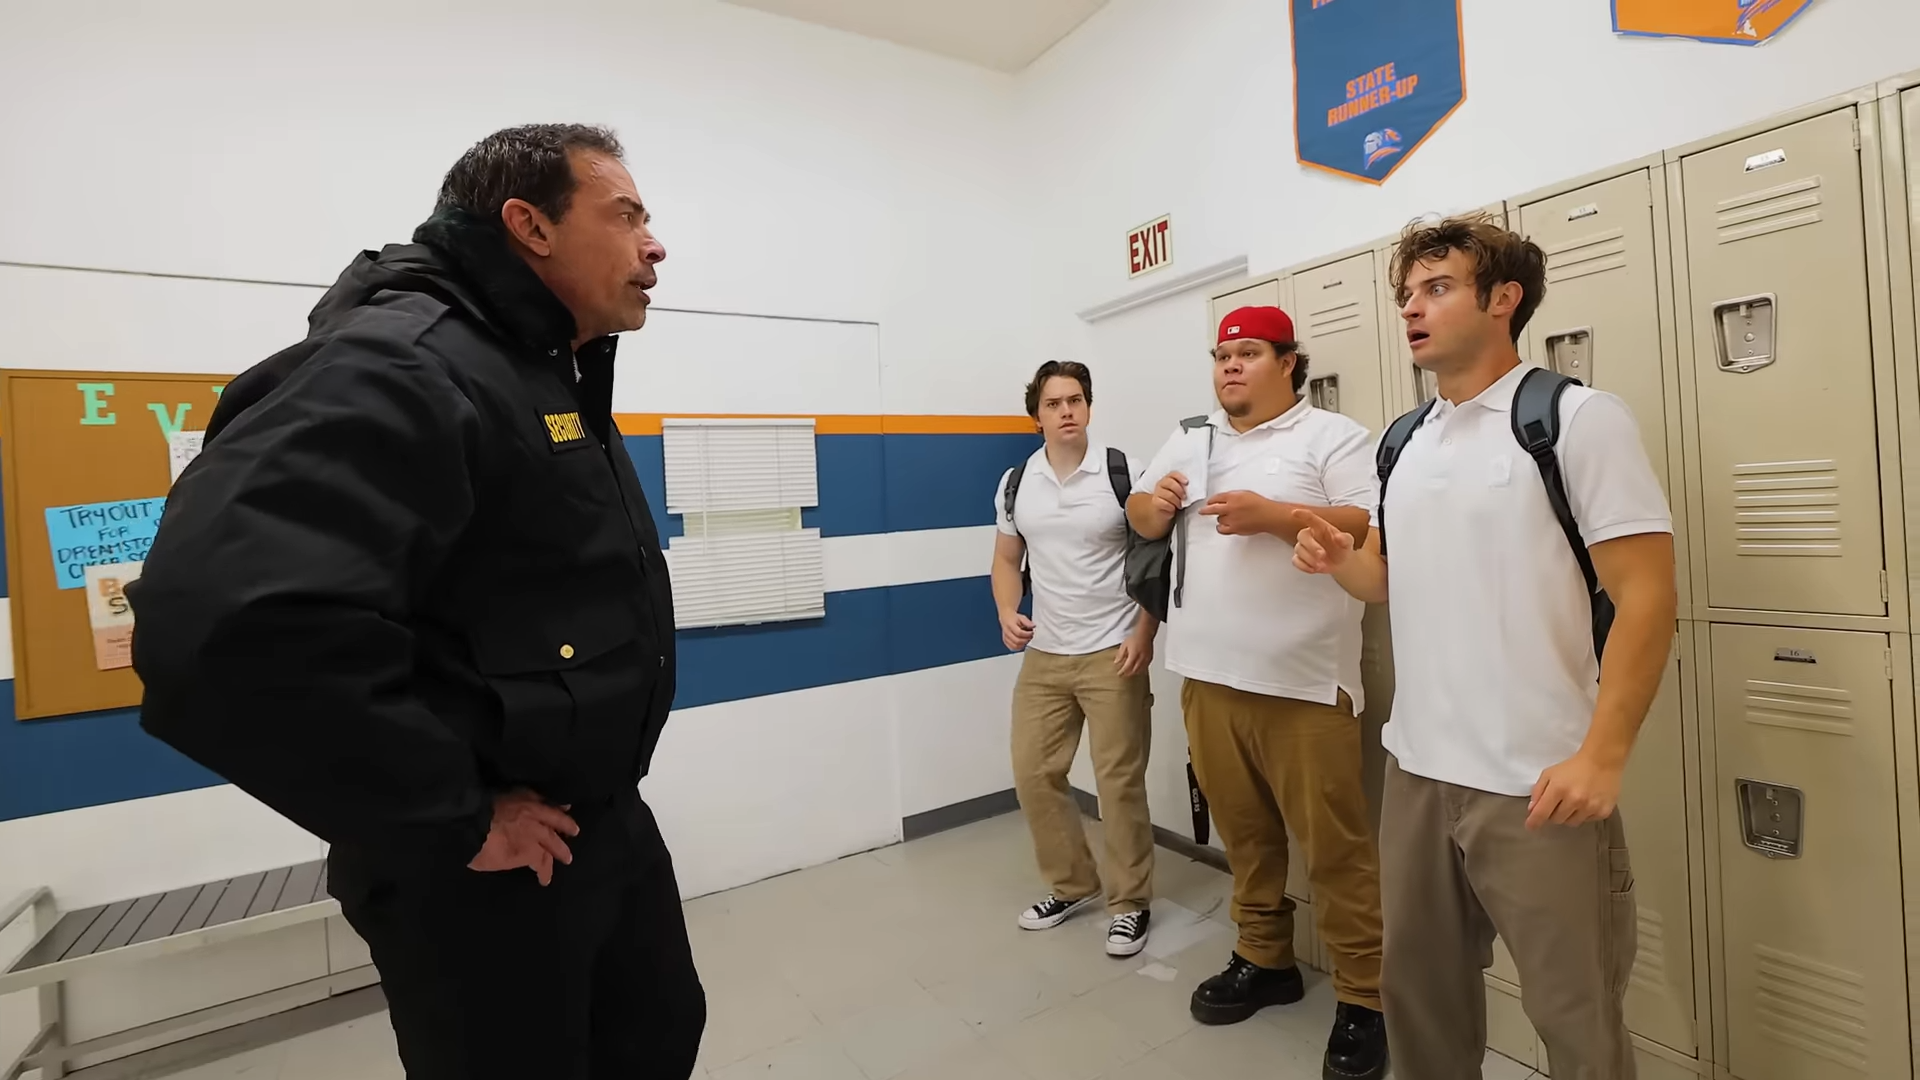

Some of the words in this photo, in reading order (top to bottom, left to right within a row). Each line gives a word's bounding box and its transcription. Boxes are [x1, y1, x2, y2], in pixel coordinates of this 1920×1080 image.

[1346, 62, 1396, 99] STATE
[1327, 74, 1418, 127] RUNNER-UP
[1129, 219, 1168, 274] EXIT
[544, 411, 586, 443] SECURITY
[98, 526, 130, 542] FOR
